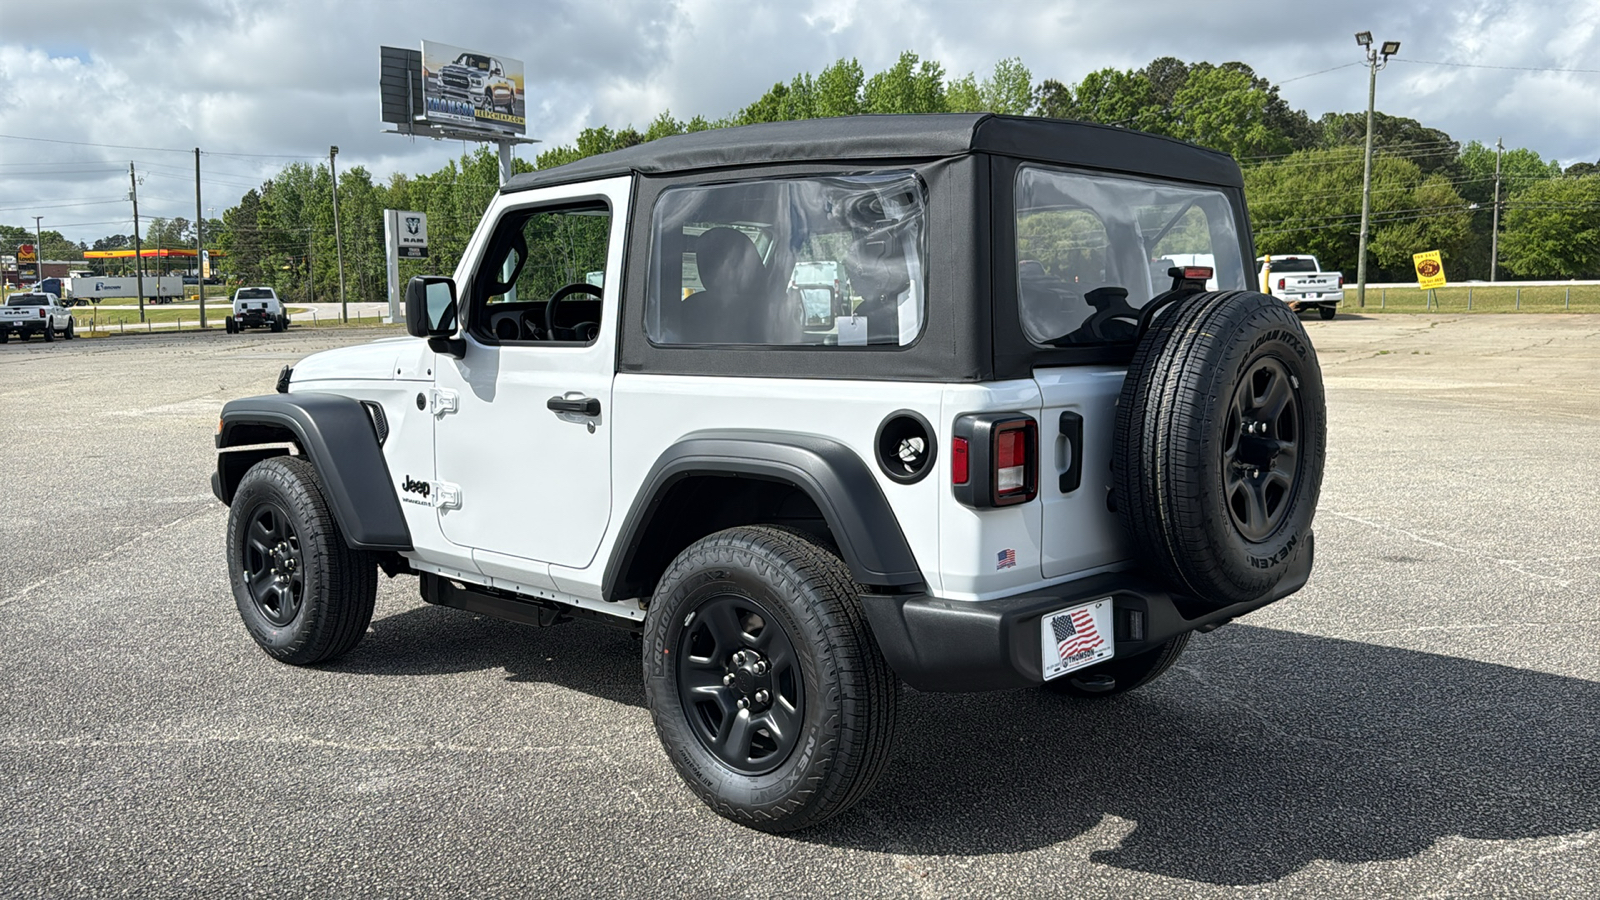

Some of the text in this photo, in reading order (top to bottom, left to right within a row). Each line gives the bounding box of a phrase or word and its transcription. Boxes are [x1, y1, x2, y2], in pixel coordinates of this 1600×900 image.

[427, 97, 475, 117] THOMSON
[1280, 330, 1307, 356] HTX2
[402, 474, 430, 498] Jeep
[1251, 537, 1298, 569] NEXEN
[654, 587, 686, 667] ROADIAN
[1068, 649, 1095, 663] THOMSON
[761, 735, 816, 804] NEXEN
